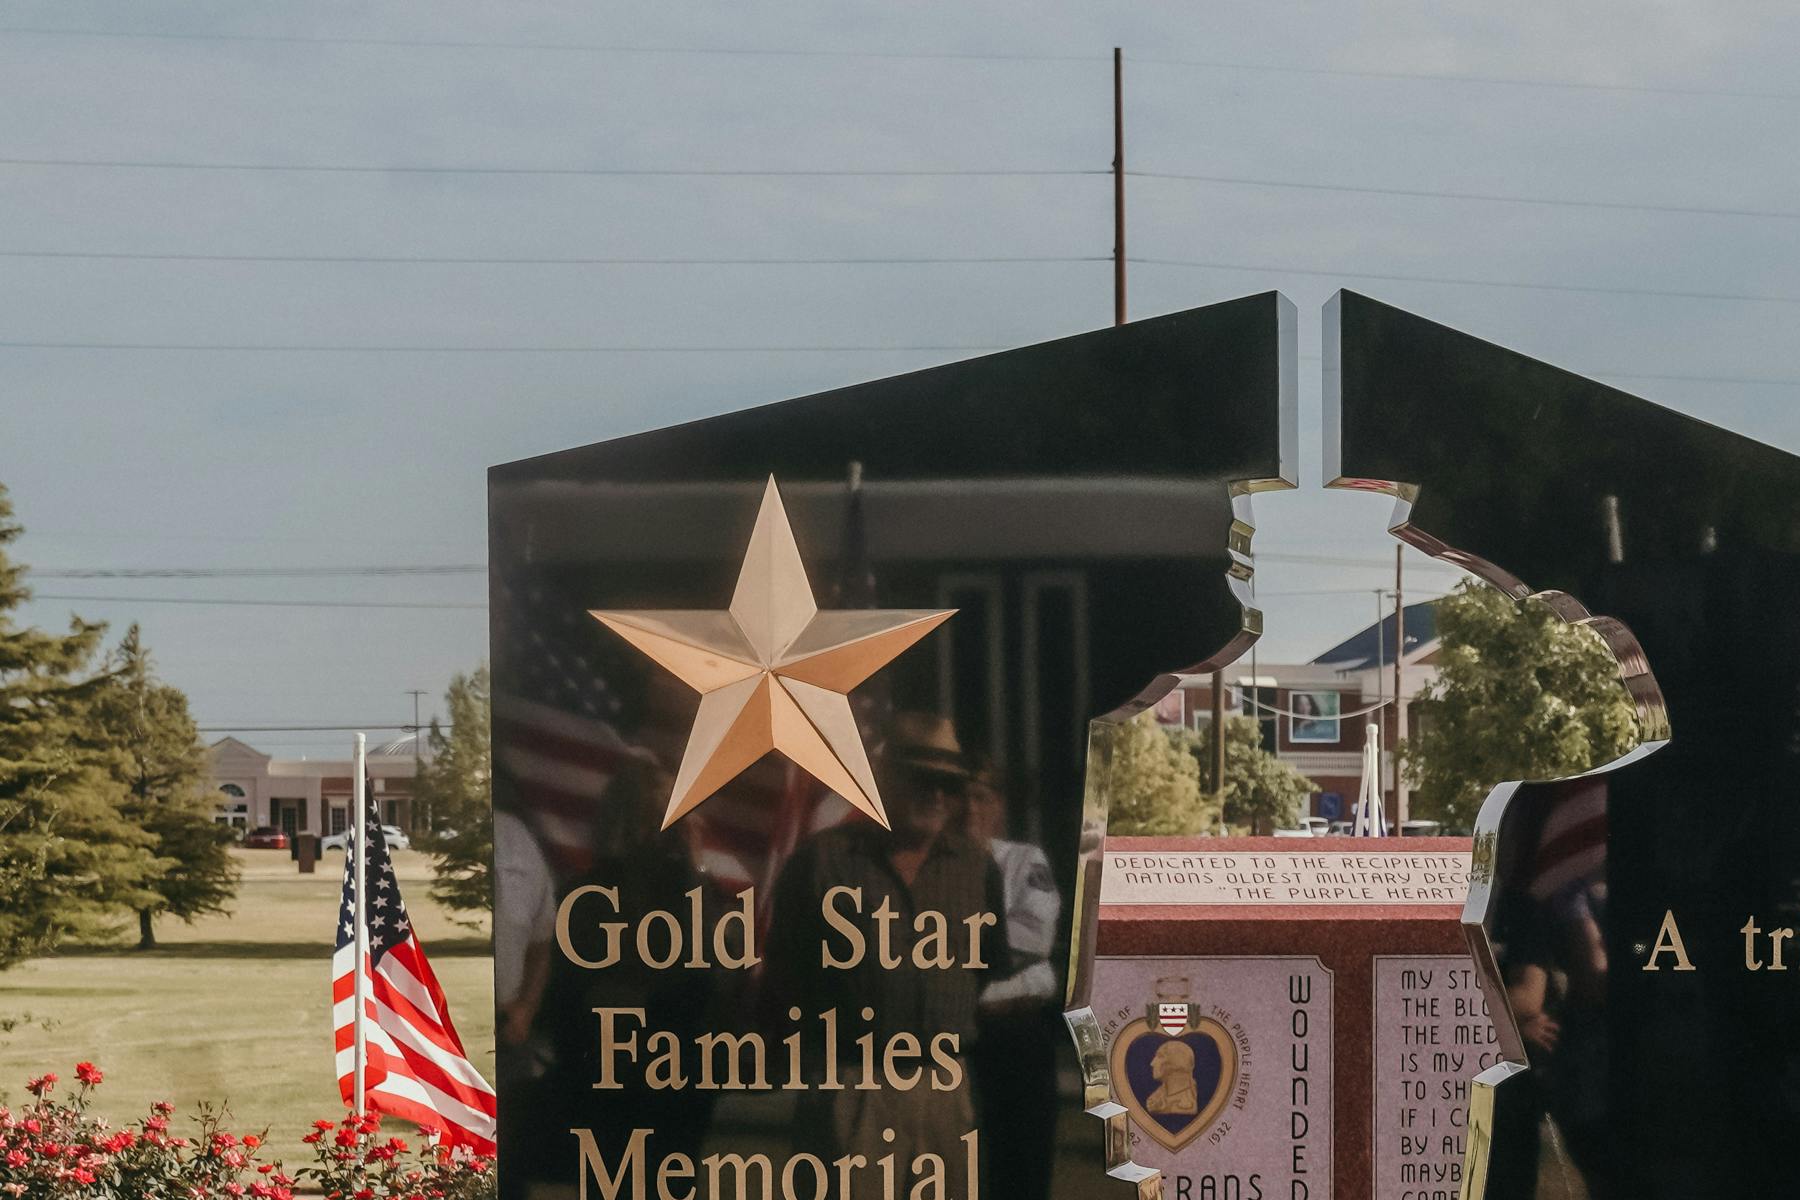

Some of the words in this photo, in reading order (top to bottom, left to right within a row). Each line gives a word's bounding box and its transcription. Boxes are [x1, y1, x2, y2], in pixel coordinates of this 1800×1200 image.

[1114, 857, 1236, 869] DEDICATED
[1250, 857, 1276, 869] TO
[1289, 857, 1329, 869] THE
[1342, 857, 1462, 869] RECIPIENTS
[1125, 872, 1214, 884] NATIONS
[1226, 872, 1301, 884] OLDEST
[1316, 872, 1410, 884] MILITARY
[1288, 887, 1374, 899] PURPLE
[554, 884, 763, 970] Gold
[821, 885, 998, 970] Star
[1642, 909, 1696, 971] A
[1401, 970, 1433, 990] MY
[1401, 998, 1440, 1017] THE
[1401, 1026, 1440, 1045] THE
[592, 1006, 964, 1092] Families
[1211, 1004, 1232, 1024] THE
[1233, 1072, 1251, 1112] HEART
[1401, 1053, 1418, 1073] IS
[1433, 1053, 1464, 1073] MY
[1401, 1081, 1426, 1100] TO
[1401, 1108, 1418, 1128] IF
[1432, 1108, 1436, 1128] I
[1401, 1136, 1428, 1156] BY
